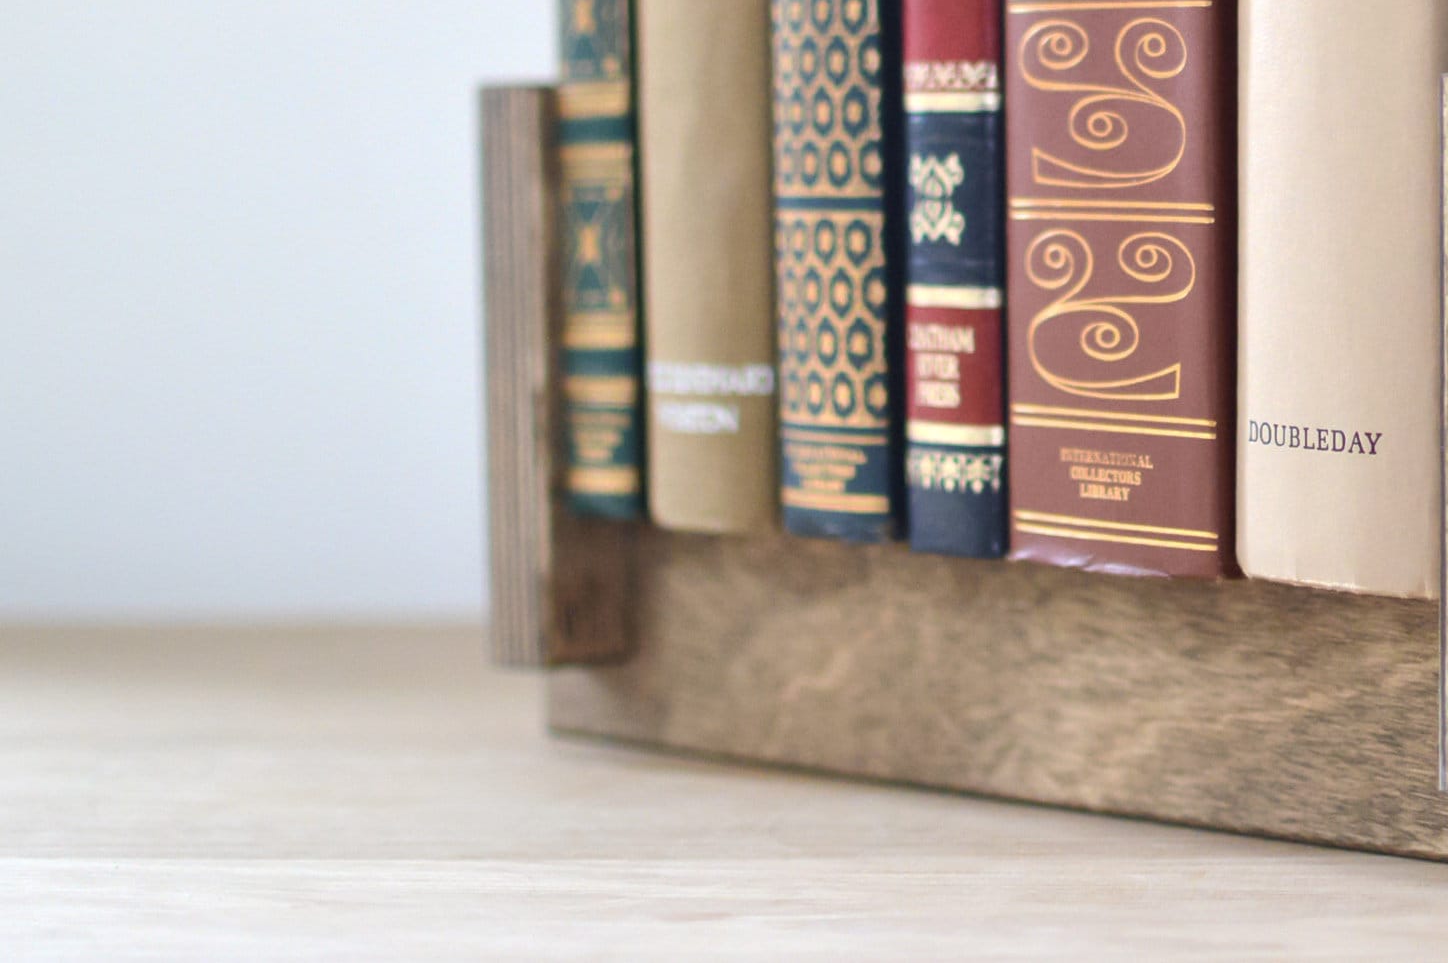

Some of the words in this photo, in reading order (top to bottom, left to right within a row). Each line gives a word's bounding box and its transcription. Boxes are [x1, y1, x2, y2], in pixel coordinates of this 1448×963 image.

[1247, 419, 1383, 455] DOUBLEDAY
[1070, 465, 1143, 486] COLLECTORS
[1079, 482, 1131, 501] LIBRARY
